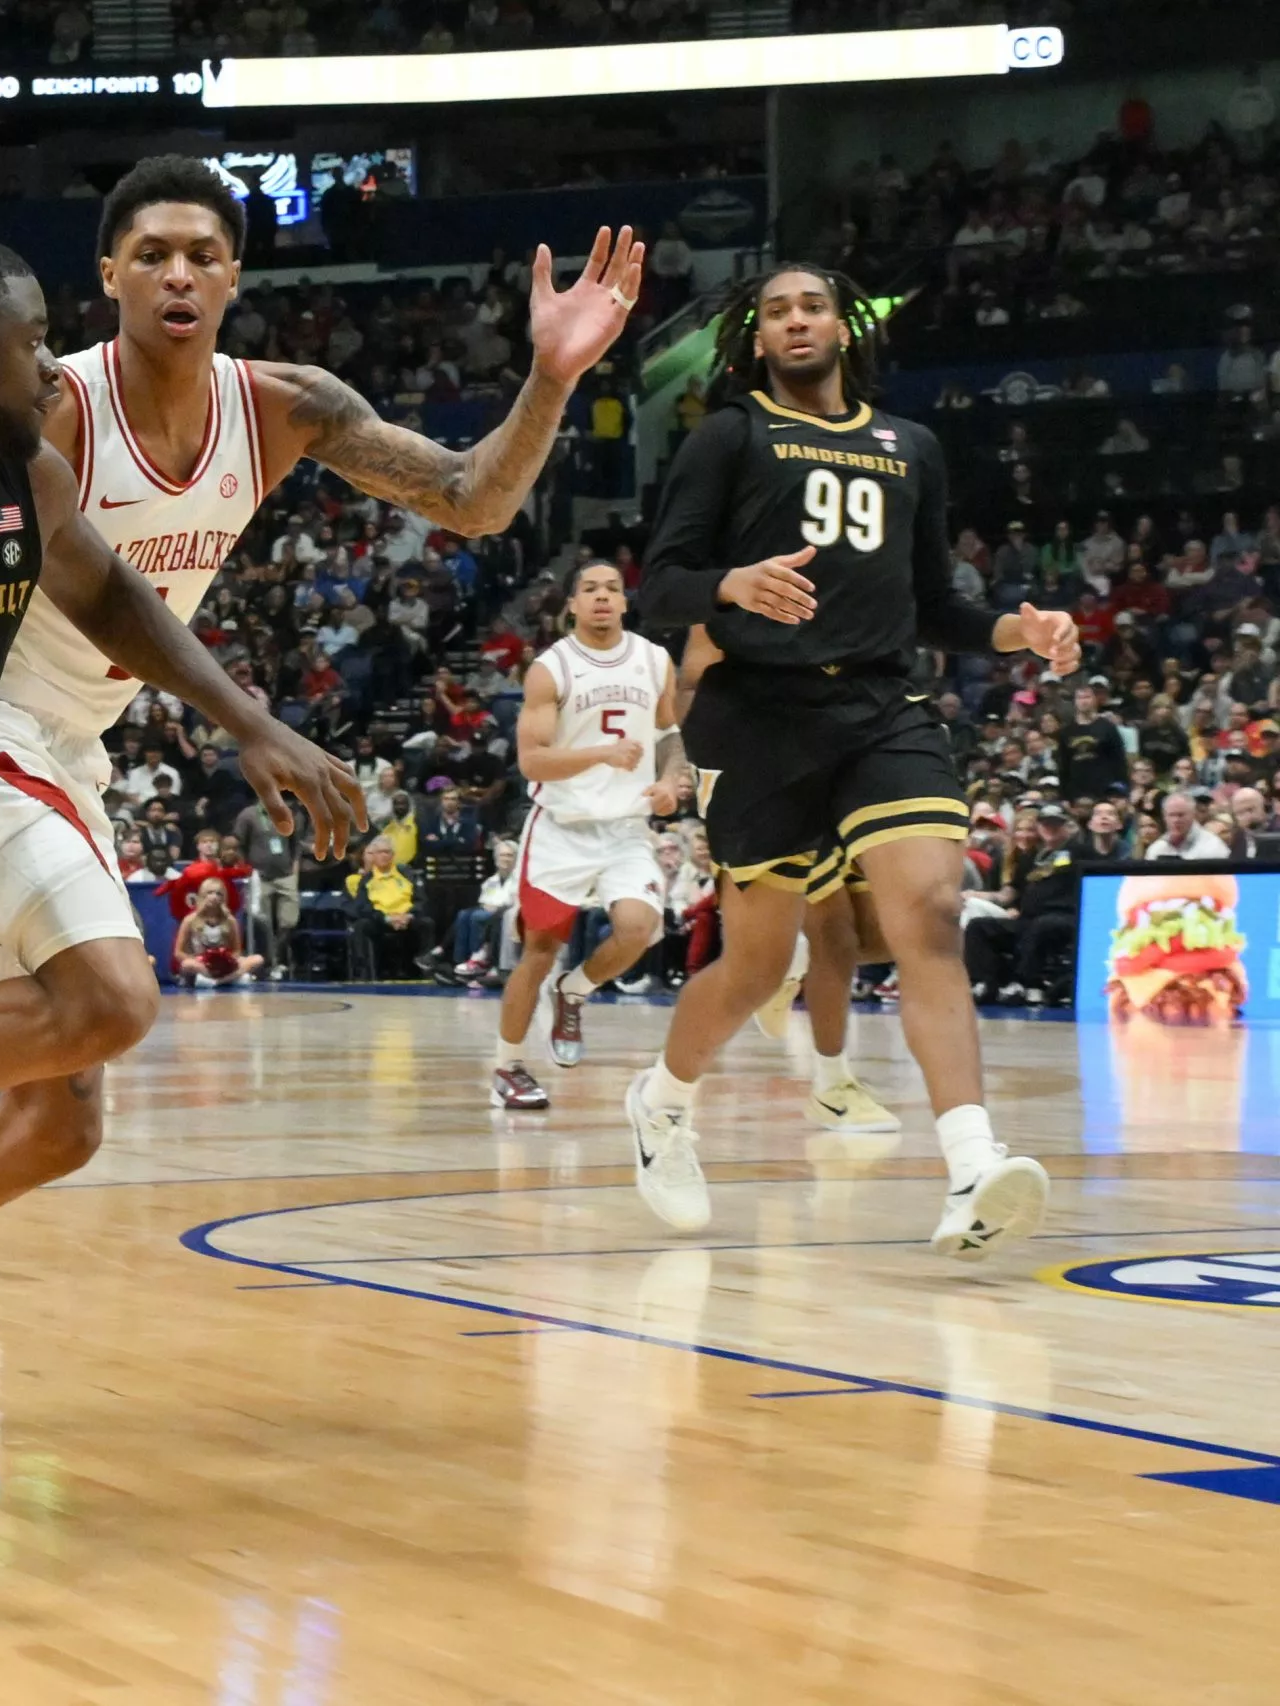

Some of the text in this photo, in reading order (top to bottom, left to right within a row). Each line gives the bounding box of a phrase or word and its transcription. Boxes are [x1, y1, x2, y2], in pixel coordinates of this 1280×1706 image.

[1013, 35, 1053, 60] CC
[32, 77, 93, 96] BENCH
[94, 76, 160, 94] POINTS
[772, 443, 907, 478] VANDERBILT
[800, 468, 885, 553] 99
[601, 709, 626, 739] 5
